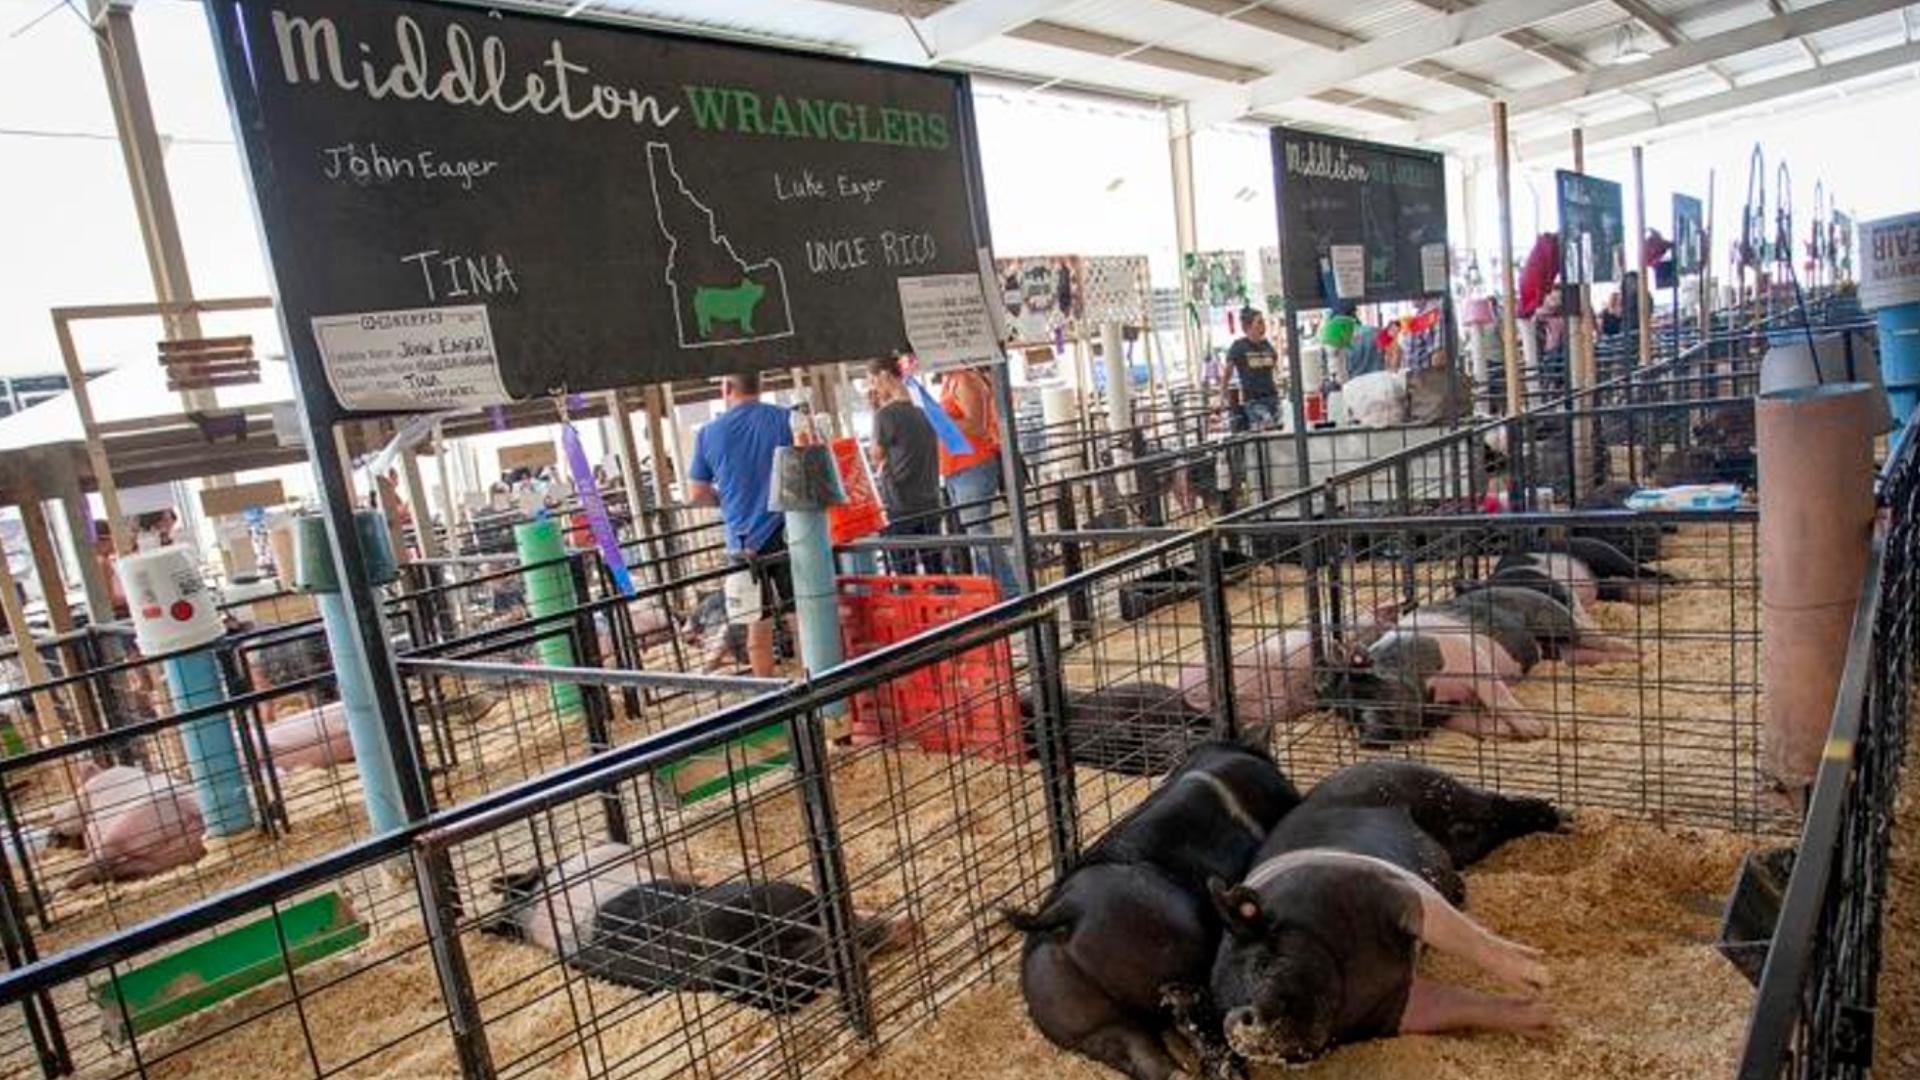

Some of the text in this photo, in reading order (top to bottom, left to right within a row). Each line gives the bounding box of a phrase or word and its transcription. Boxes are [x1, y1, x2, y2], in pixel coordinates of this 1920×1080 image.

[272, 10, 949, 149] Middleton WRANGLERS
[324, 143, 498, 190] John Eager
[1285, 141, 1369, 182] Middleton
[774, 171, 887, 204] Luke Eager
[805, 230, 937, 274] UNCLE RICO
[401, 249, 519, 301] TINA
